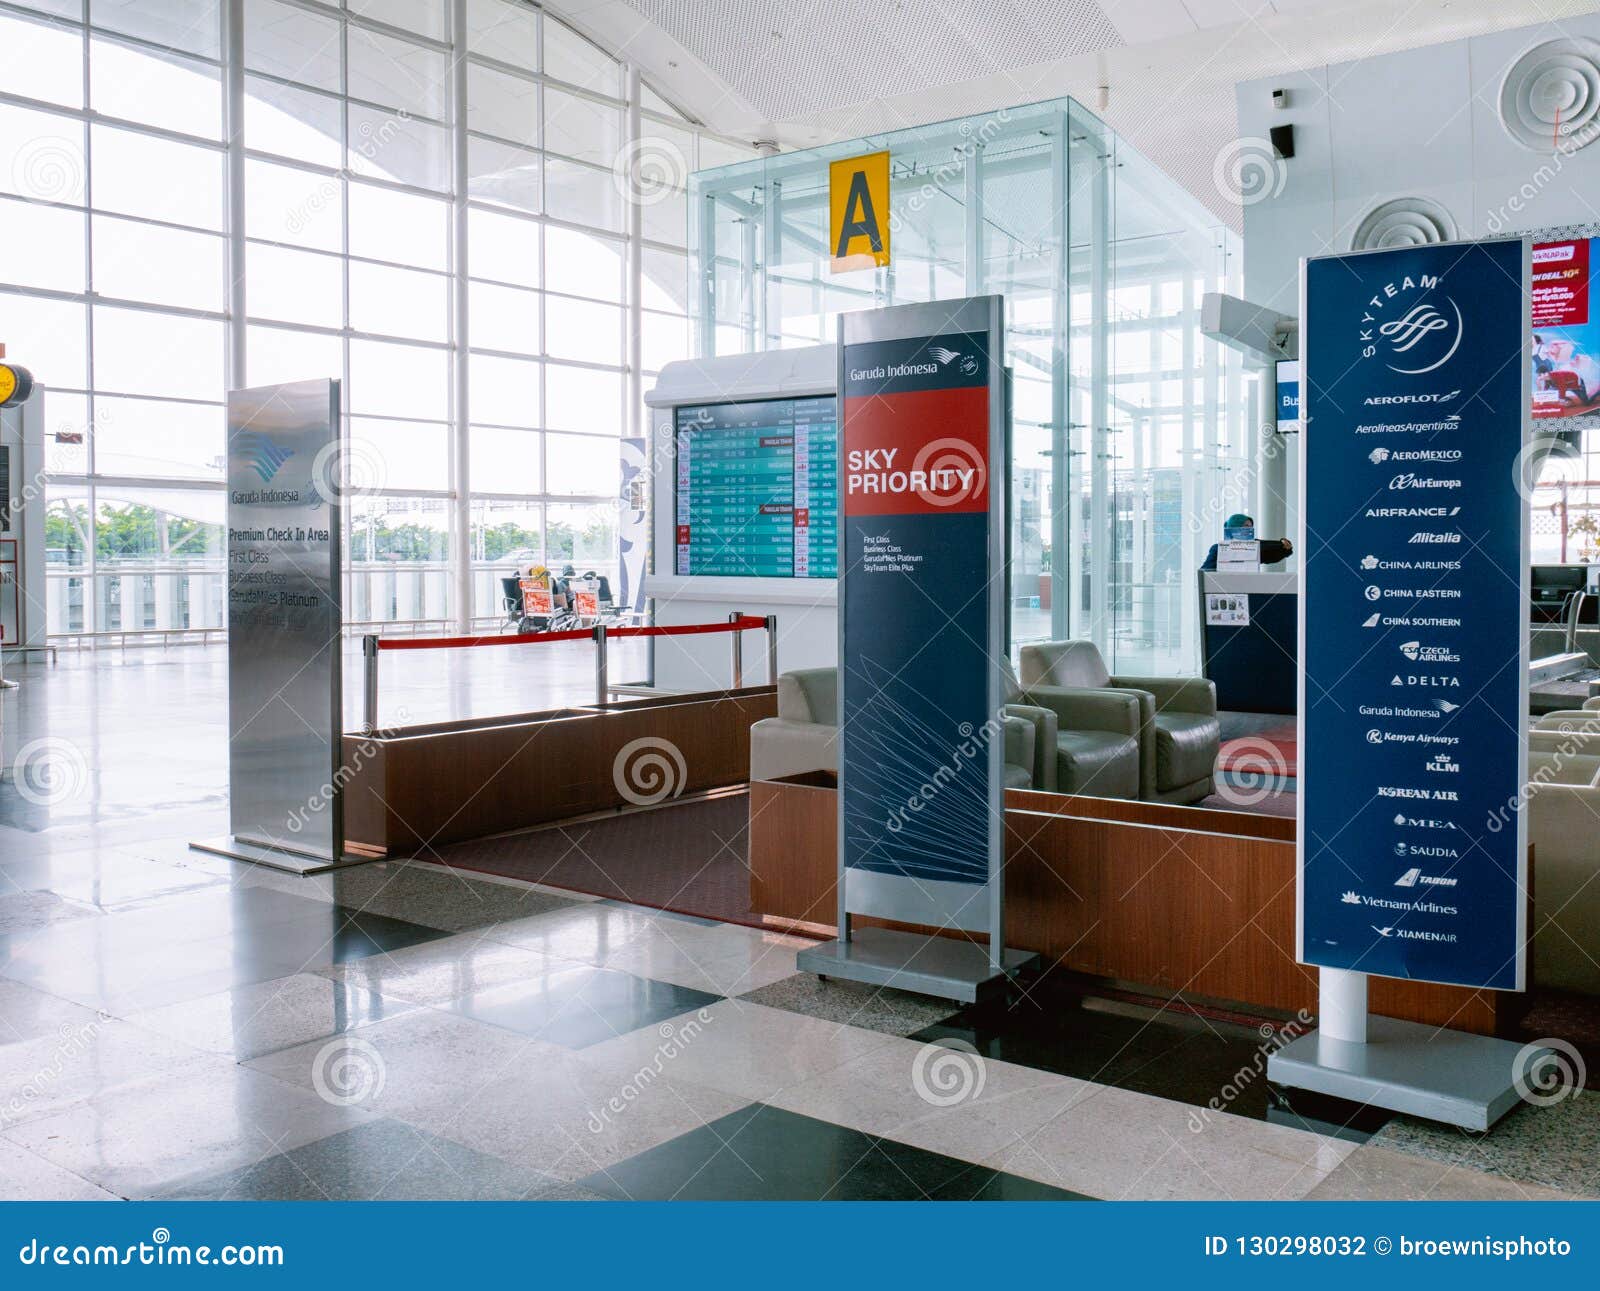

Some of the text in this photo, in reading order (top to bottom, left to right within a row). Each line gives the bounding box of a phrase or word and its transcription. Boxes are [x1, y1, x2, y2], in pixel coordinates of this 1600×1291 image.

[836, 171, 883, 258] A
[1360, 275, 1438, 358] SKYTEAM
[850, 363, 938, 381] Garuda Indonesia
[1364, 393, 1440, 406] AEROFLOT
[848, 448, 898, 472] SKY
[848, 468, 975, 495] PRIORITY
[1411, 478, 1461, 490] AirEuropa
[232, 488, 299, 505] Garuda Indonesia
[1366, 507, 1447, 517] AIRFRANCE
[229, 527, 329, 542] Premium Check In Area
[864, 536, 875, 545] First
[1408, 532, 1461, 544] Alitalia
[887, 545, 902, 553] Class
[229, 550, 270, 564] First Class
[897, 554, 923, 562] Platinum
[864, 564, 888, 573] SkyTeam
[901, 564, 914, 572] Plus
[1379, 561, 1461, 570] CHINA AIRLINES
[229, 570, 287, 585] Business Class
[280, 591, 319, 608] Platinum
[1384, 590, 1461, 598] CHINA EASTERN
[1383, 617, 1461, 627] CHINA SOUTHERN
[1420, 647, 1450, 655] CZECH
[1419, 654, 1461, 662] AIRLINES
[1408, 676, 1460, 687] DELTA
[1359, 705, 1441, 718] Garuda Indonesia
[1384, 732, 1460, 746] Kenya Airways
[1426, 762, 1460, 773] KLM
[1378, 787, 1459, 801] KOREAN AIR
[1408, 819, 1458, 830] MEA
[1410, 845, 1459, 858] SAUDIA
[1362, 895, 1459, 915] Vietnam Airlines
